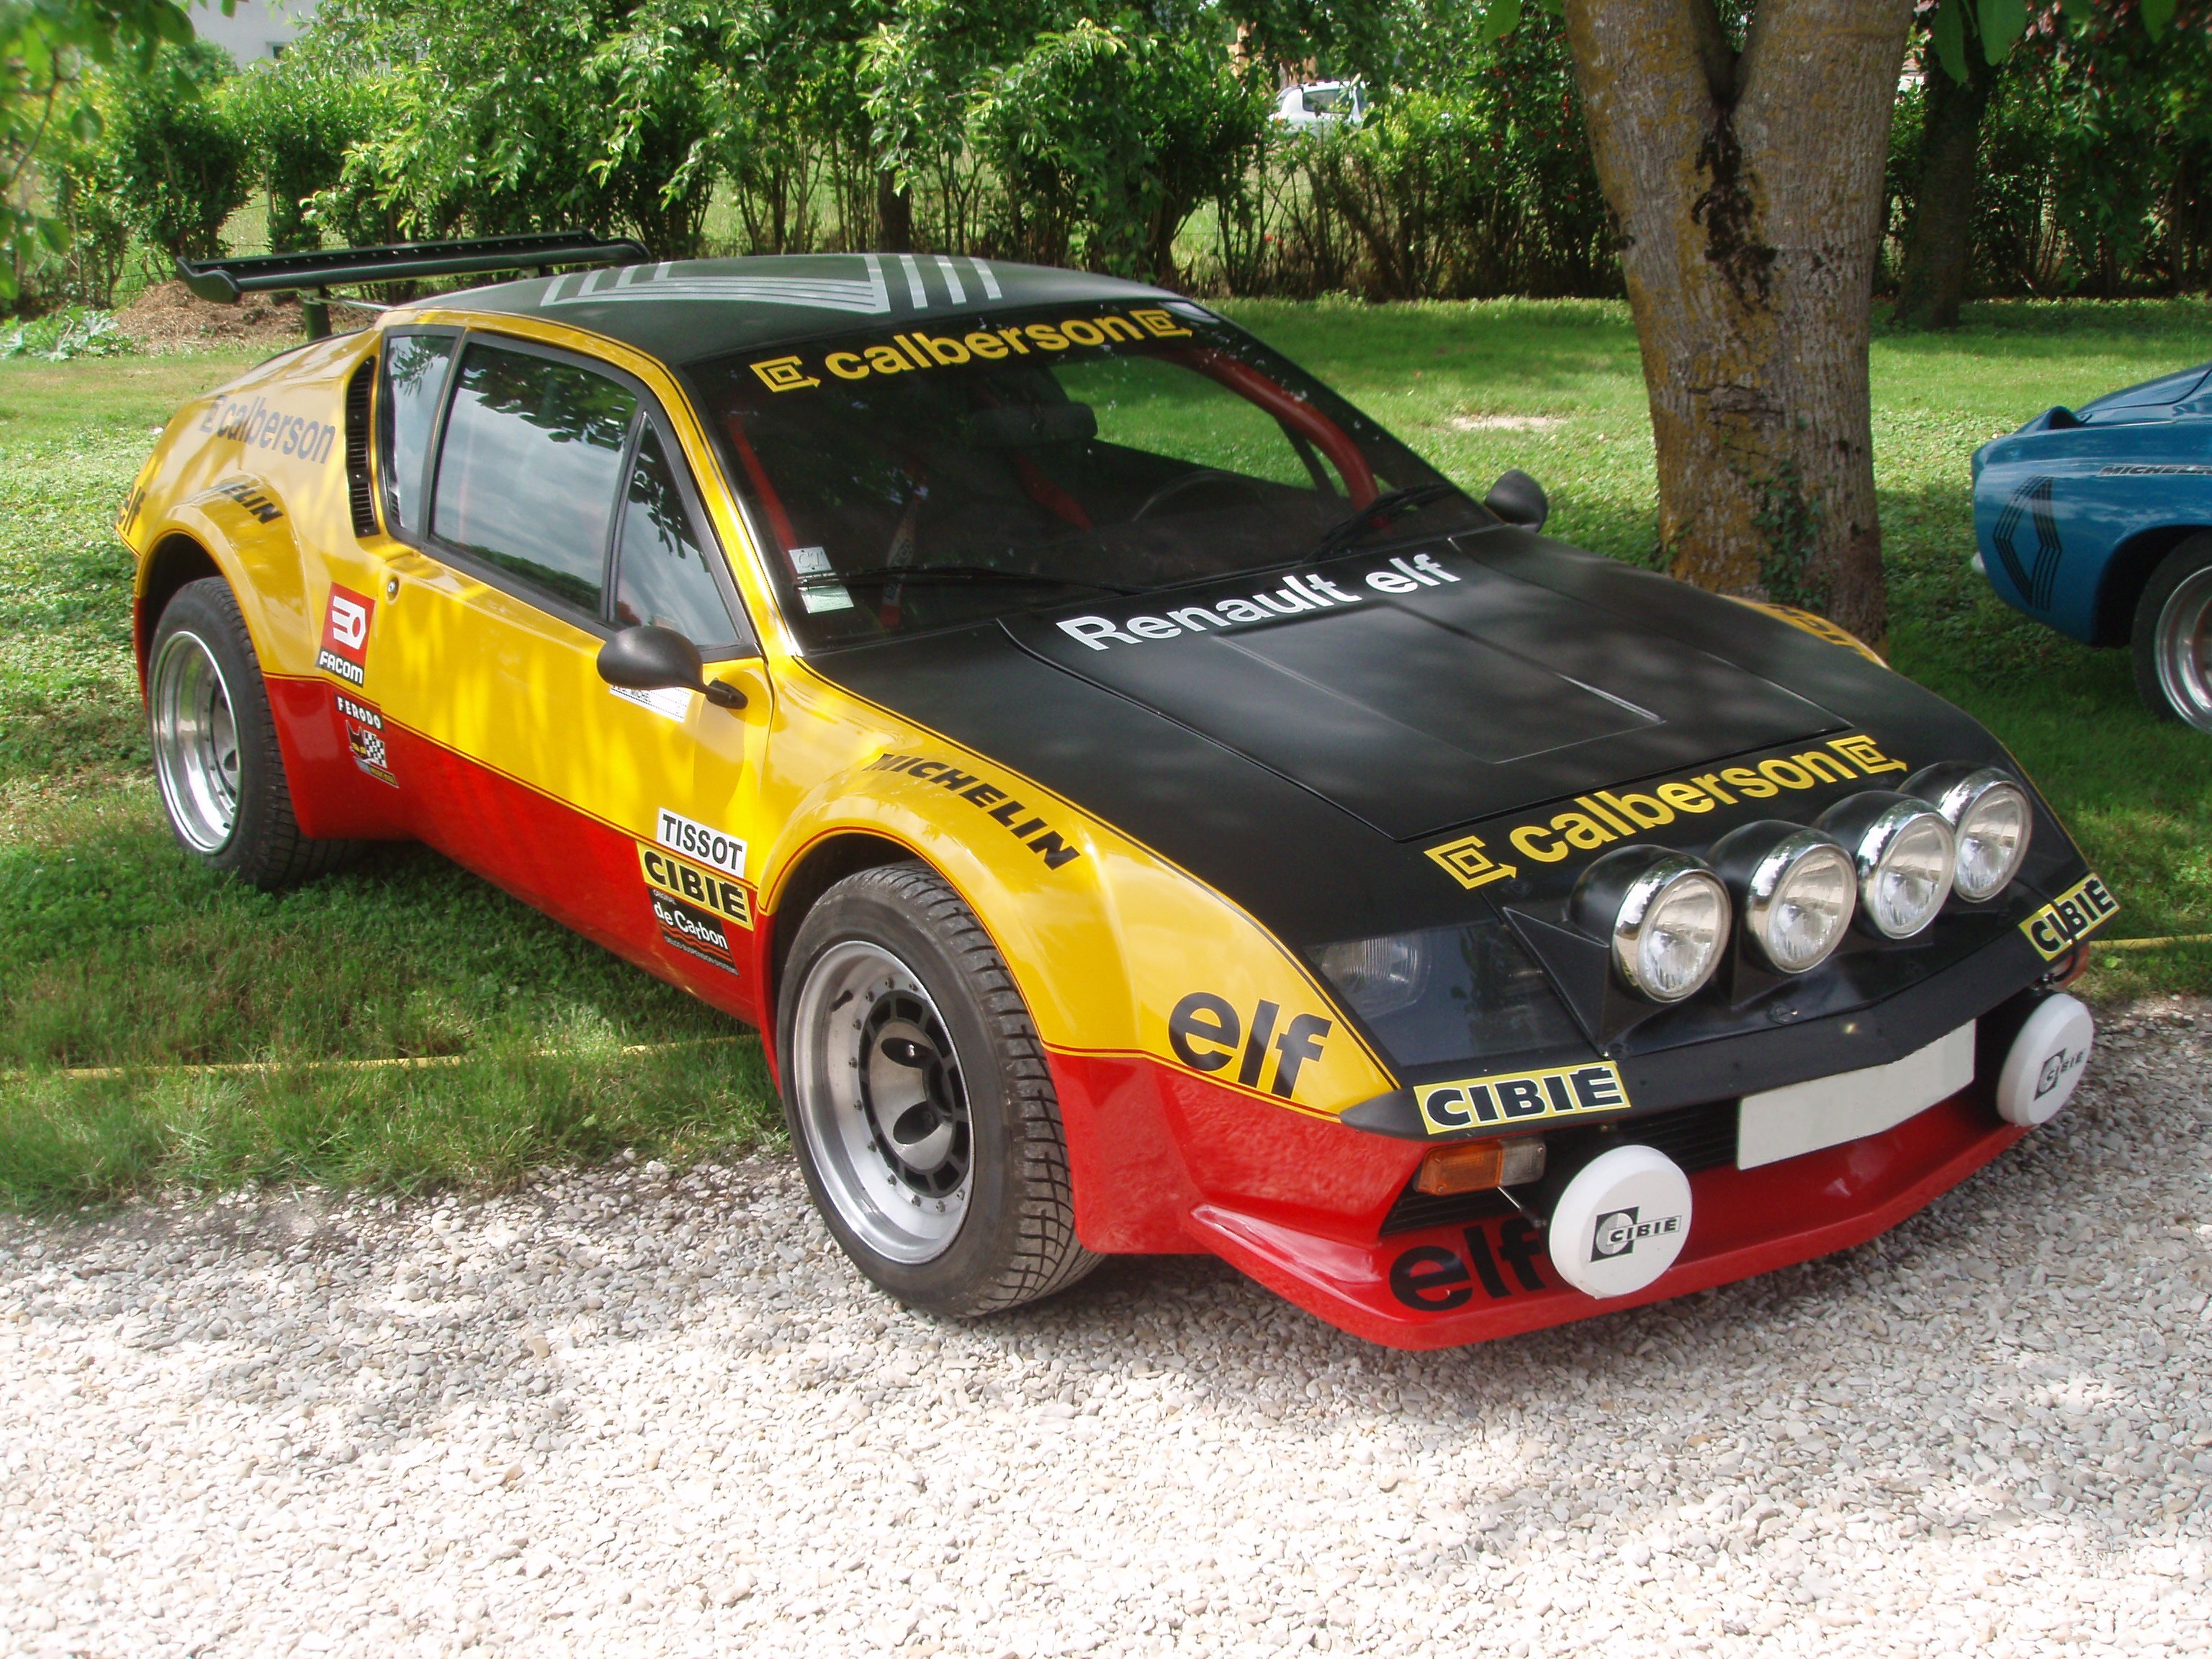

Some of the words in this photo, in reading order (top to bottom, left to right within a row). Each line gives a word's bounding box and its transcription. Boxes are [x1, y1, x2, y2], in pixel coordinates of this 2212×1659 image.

[824, 314, 1146, 380] calberson
[217, 396, 336, 464] calberson
[1056, 574, 1362, 651] Renault
[1365, 553, 1461, 593] elf
[319, 650, 364, 684] FACOM
[337, 696, 382, 729] FERODO
[861, 752, 1082, 871] MICHELIN
[1509, 750, 1858, 863] calberson
[662, 813, 743, 871] TISSOT
[654, 901, 674, 926] de
[674, 910, 729, 950] Carbon
[1168, 991, 1333, 1100] elf
[1389, 1217, 1546, 1312] elf
